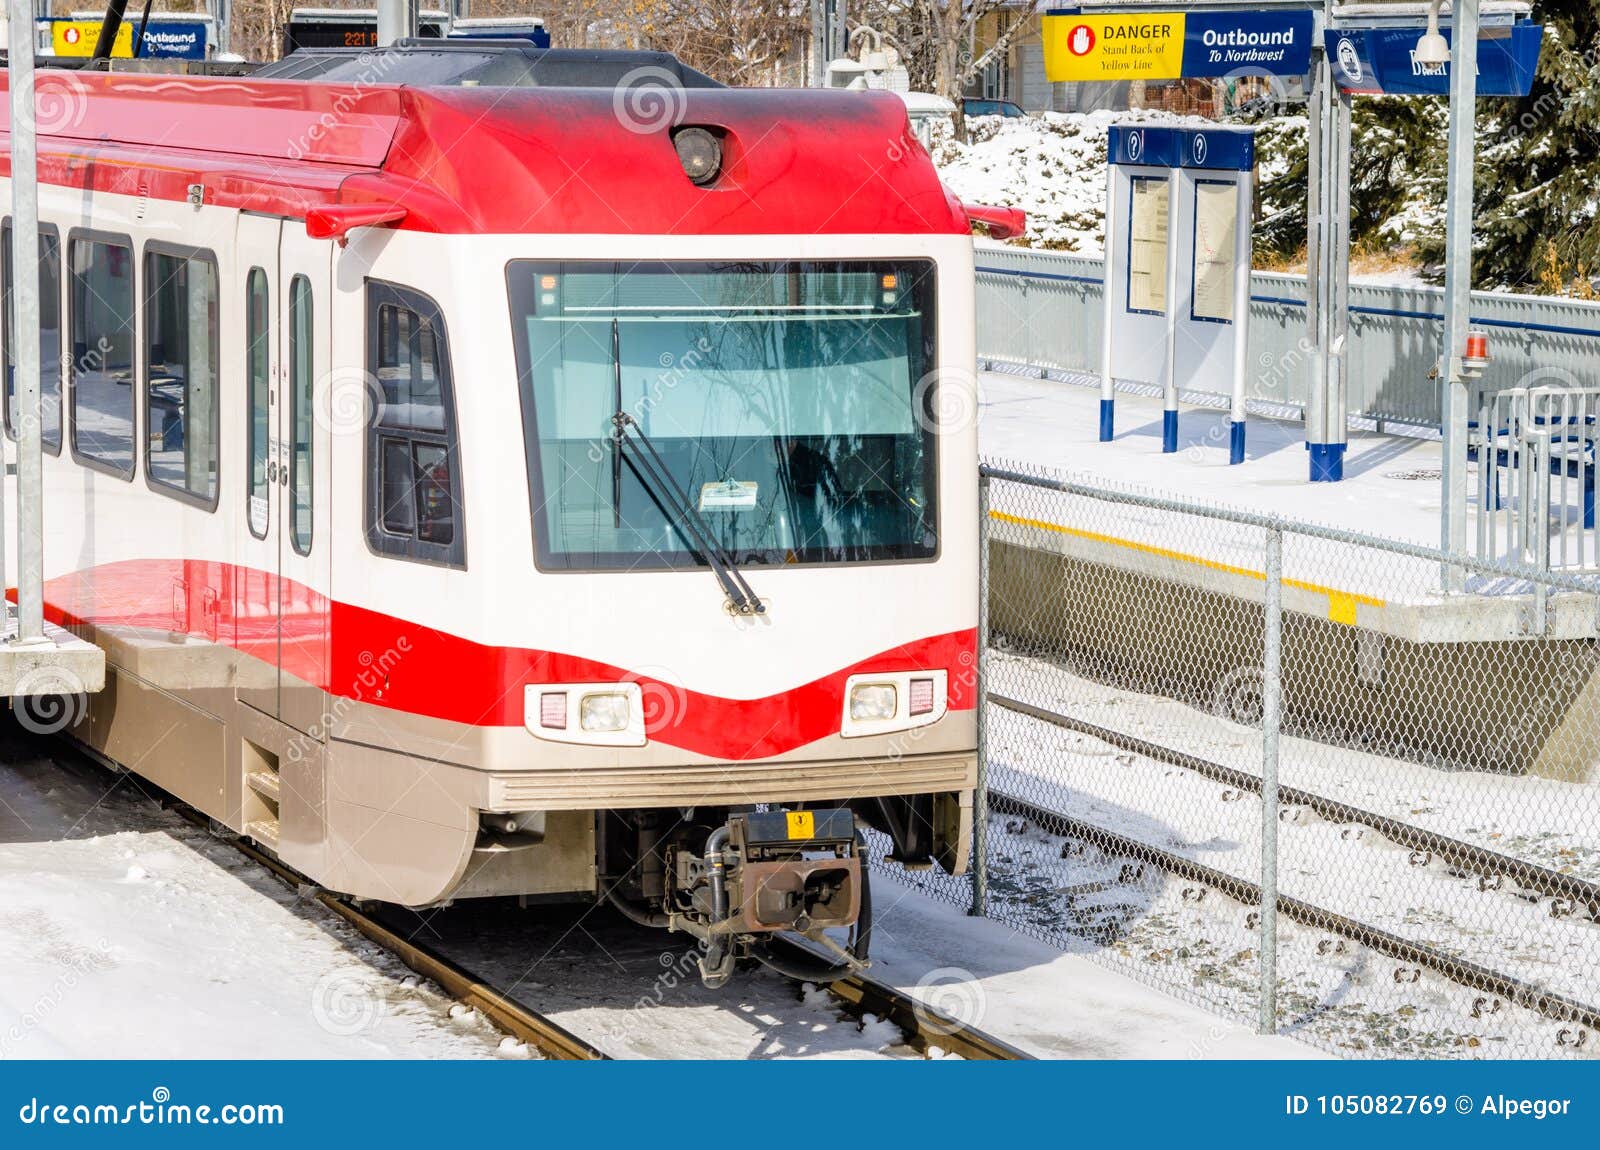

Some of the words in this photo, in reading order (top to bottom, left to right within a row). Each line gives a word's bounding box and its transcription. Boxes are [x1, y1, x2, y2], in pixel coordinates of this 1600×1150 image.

[345, 32, 365, 46] 2:21
[1103, 24, 1171, 40] DANGER
[1203, 27, 1294, 47] Outbound
[1102, 44, 1128, 55] Stand
[1131, 43, 1152, 54] Back
[1155, 43, 1165, 55] of
[1208, 49, 1221, 63] To
[1224, 48, 1285, 63] Northwest
[1101, 60, 1130, 72] Yellow
[1133, 60, 1153, 70] Line
